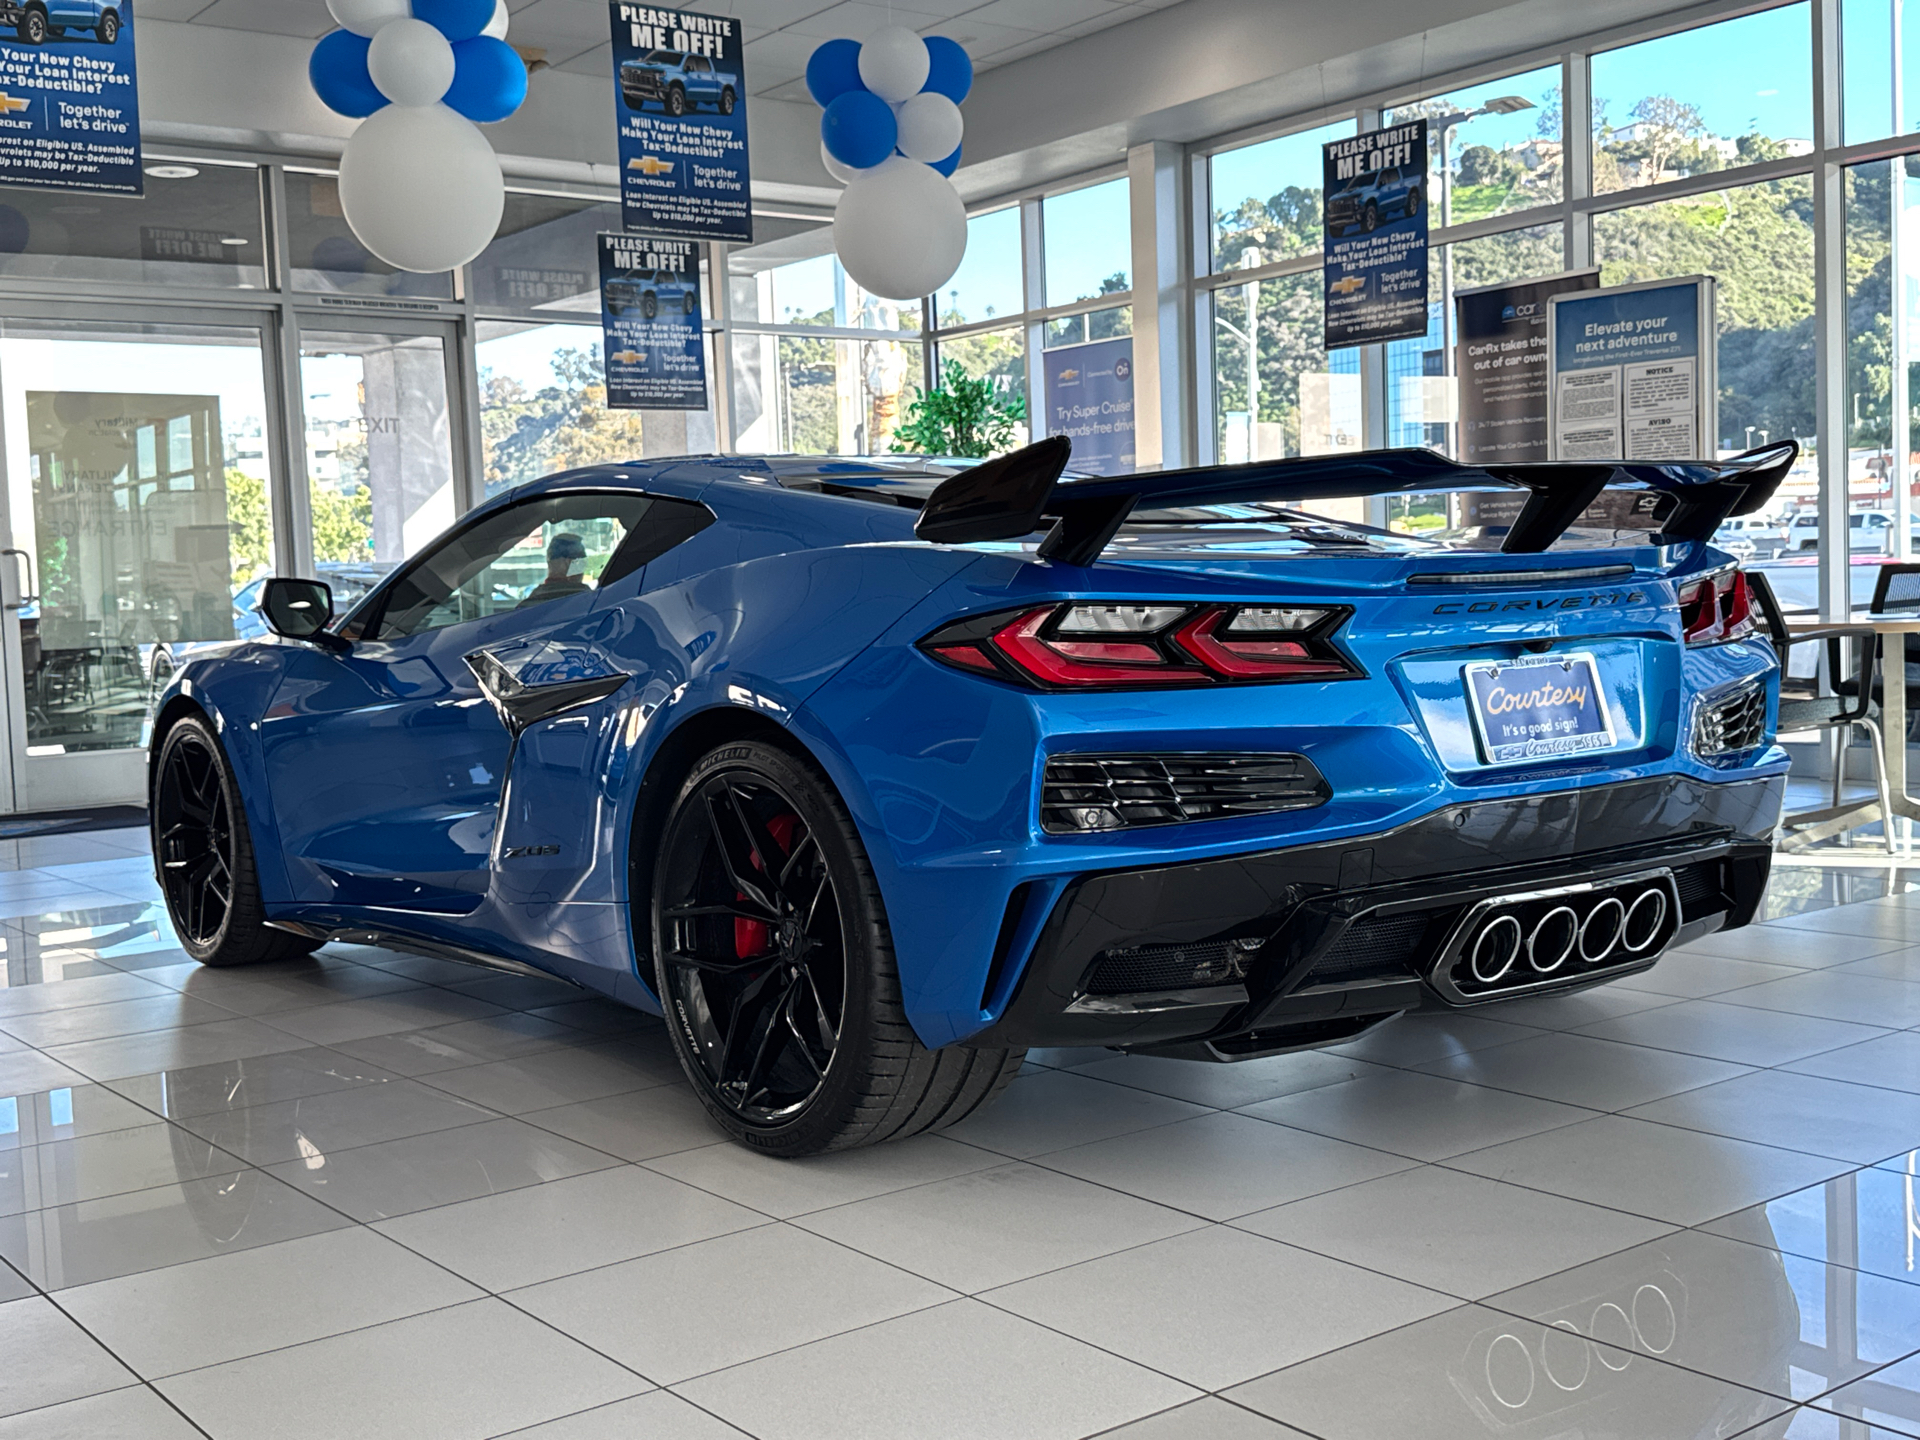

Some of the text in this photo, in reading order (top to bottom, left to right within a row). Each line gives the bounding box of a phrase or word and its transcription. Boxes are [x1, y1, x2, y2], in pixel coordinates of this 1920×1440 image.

[620, 6, 731, 36] PLEASE WRITE
[631, 24, 723, 59] ME OFF!
[1, 47, 115, 73] Your New Chevy
[0, 60, 130, 85] Your Loan Interest
[58, 102, 122, 119] Together
[60, 116, 127, 133] let's drive
[631, 117, 732, 140] Will Your New Chevy
[36, 139, 69, 150] Eligible
[88, 143, 134, 155] Assembled
[622, 126, 744, 150] Make Your Loan Interest
[1330, 125, 1418, 160] PLEASE WRITE
[34, 150, 53, 160] may
[54, 151, 66, 160] be
[68, 152, 134, 166] Tax-Deductible
[642, 139, 724, 158] Tax-Deductible?
[24, 159, 58, 170] $10,000
[60, 163, 76, 172] per
[77, 165, 100, 173] year.
[1337, 142, 1411, 180] ME OFF!
[693, 164, 738, 178] Together
[627, 176, 676, 188] CHEVROLET
[694, 176, 741, 191] let's drive
[606, 237, 691, 255] PLEASE WRITE
[1327, 238, 1424, 265] Make Your Loan Interest
[1334, 231, 1416, 253] Will Your New Chevy
[614, 251, 685, 272] ME OFF!
[1342, 251, 1407, 271] Tax-Deductible?
[1381, 269, 1418, 282] Together
[1381, 279, 1420, 293] let's drive
[629, 330, 648, 338] Your
[670, 324, 692, 333] Chevy
[1585, 316, 1668, 336] Elevate your
[1468, 337, 1547, 356] CarRx takes the
[1576, 332, 1677, 353] next adventure
[663, 354, 696, 363] Together
[1474, 361, 1490, 370] out
[1492, 356, 1503, 368] of
[1573, 355, 1604, 363] Introducing
[1646, 367, 1673, 375] NOTICE
[1057, 400, 1131, 421] Try Super Cruise
[357, 417, 400, 433] EXIT
[1063, 422, 1112, 437] hands-free
[1433, 592, 1647, 615] CORVETTE
[1487, 681, 1586, 714] Courtesy
[1503, 716, 1578, 737] It's a good sign!
[1526, 738, 1577, 757] Courtesy
[700, 748, 748, 771] MICHELIN
[676, 999, 700, 1055] CORVETTE
